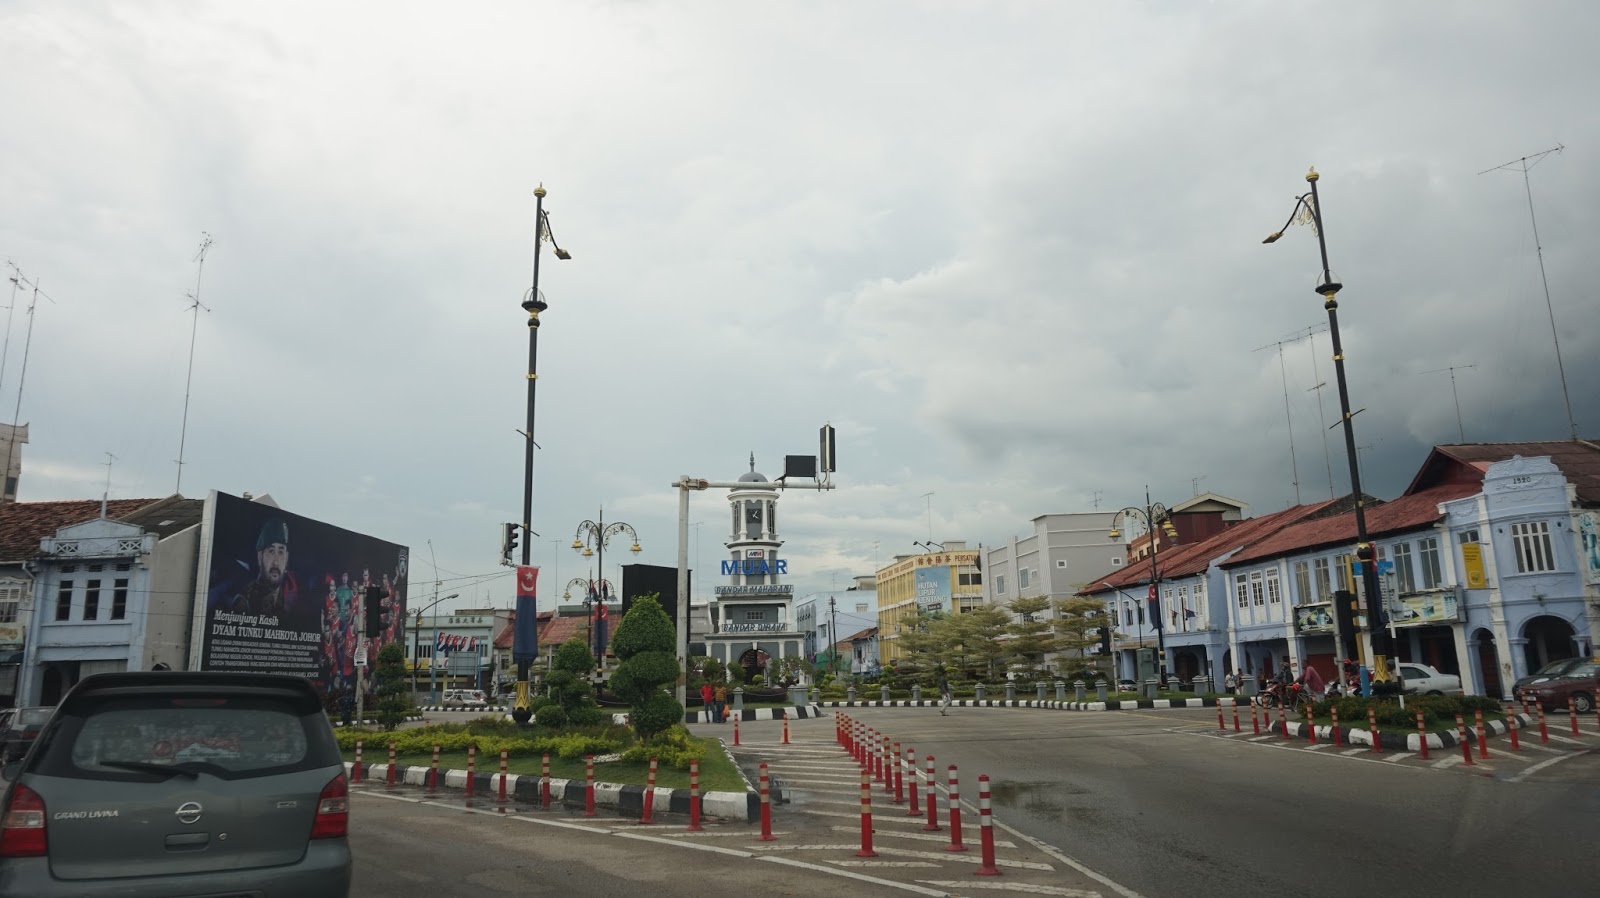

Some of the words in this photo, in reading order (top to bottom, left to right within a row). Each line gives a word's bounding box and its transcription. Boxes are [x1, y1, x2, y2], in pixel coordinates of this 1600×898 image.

[1513, 476, 1532, 484] 1920
[721, 560, 787, 575] MUAR
[716, 586, 748, 594] BANDAR
[749, 585, 792, 593] MAHARANI
[917, 581, 938, 590] HUTAN
[918, 588, 936, 597] LIPUR
[214, 609, 258, 626] Menjunjung
[258, 614, 279, 626] Kasih
[723, 623, 755, 632] BANDAR
[212, 624, 236, 636] DYAM
[237, 626, 264, 638] TUNKU
[264, 629, 298, 641] MAHKOTA
[299, 632, 322, 643] JOHOR
[54, 811, 87, 819] GRAND
[88, 810, 119, 818] LIVINA
